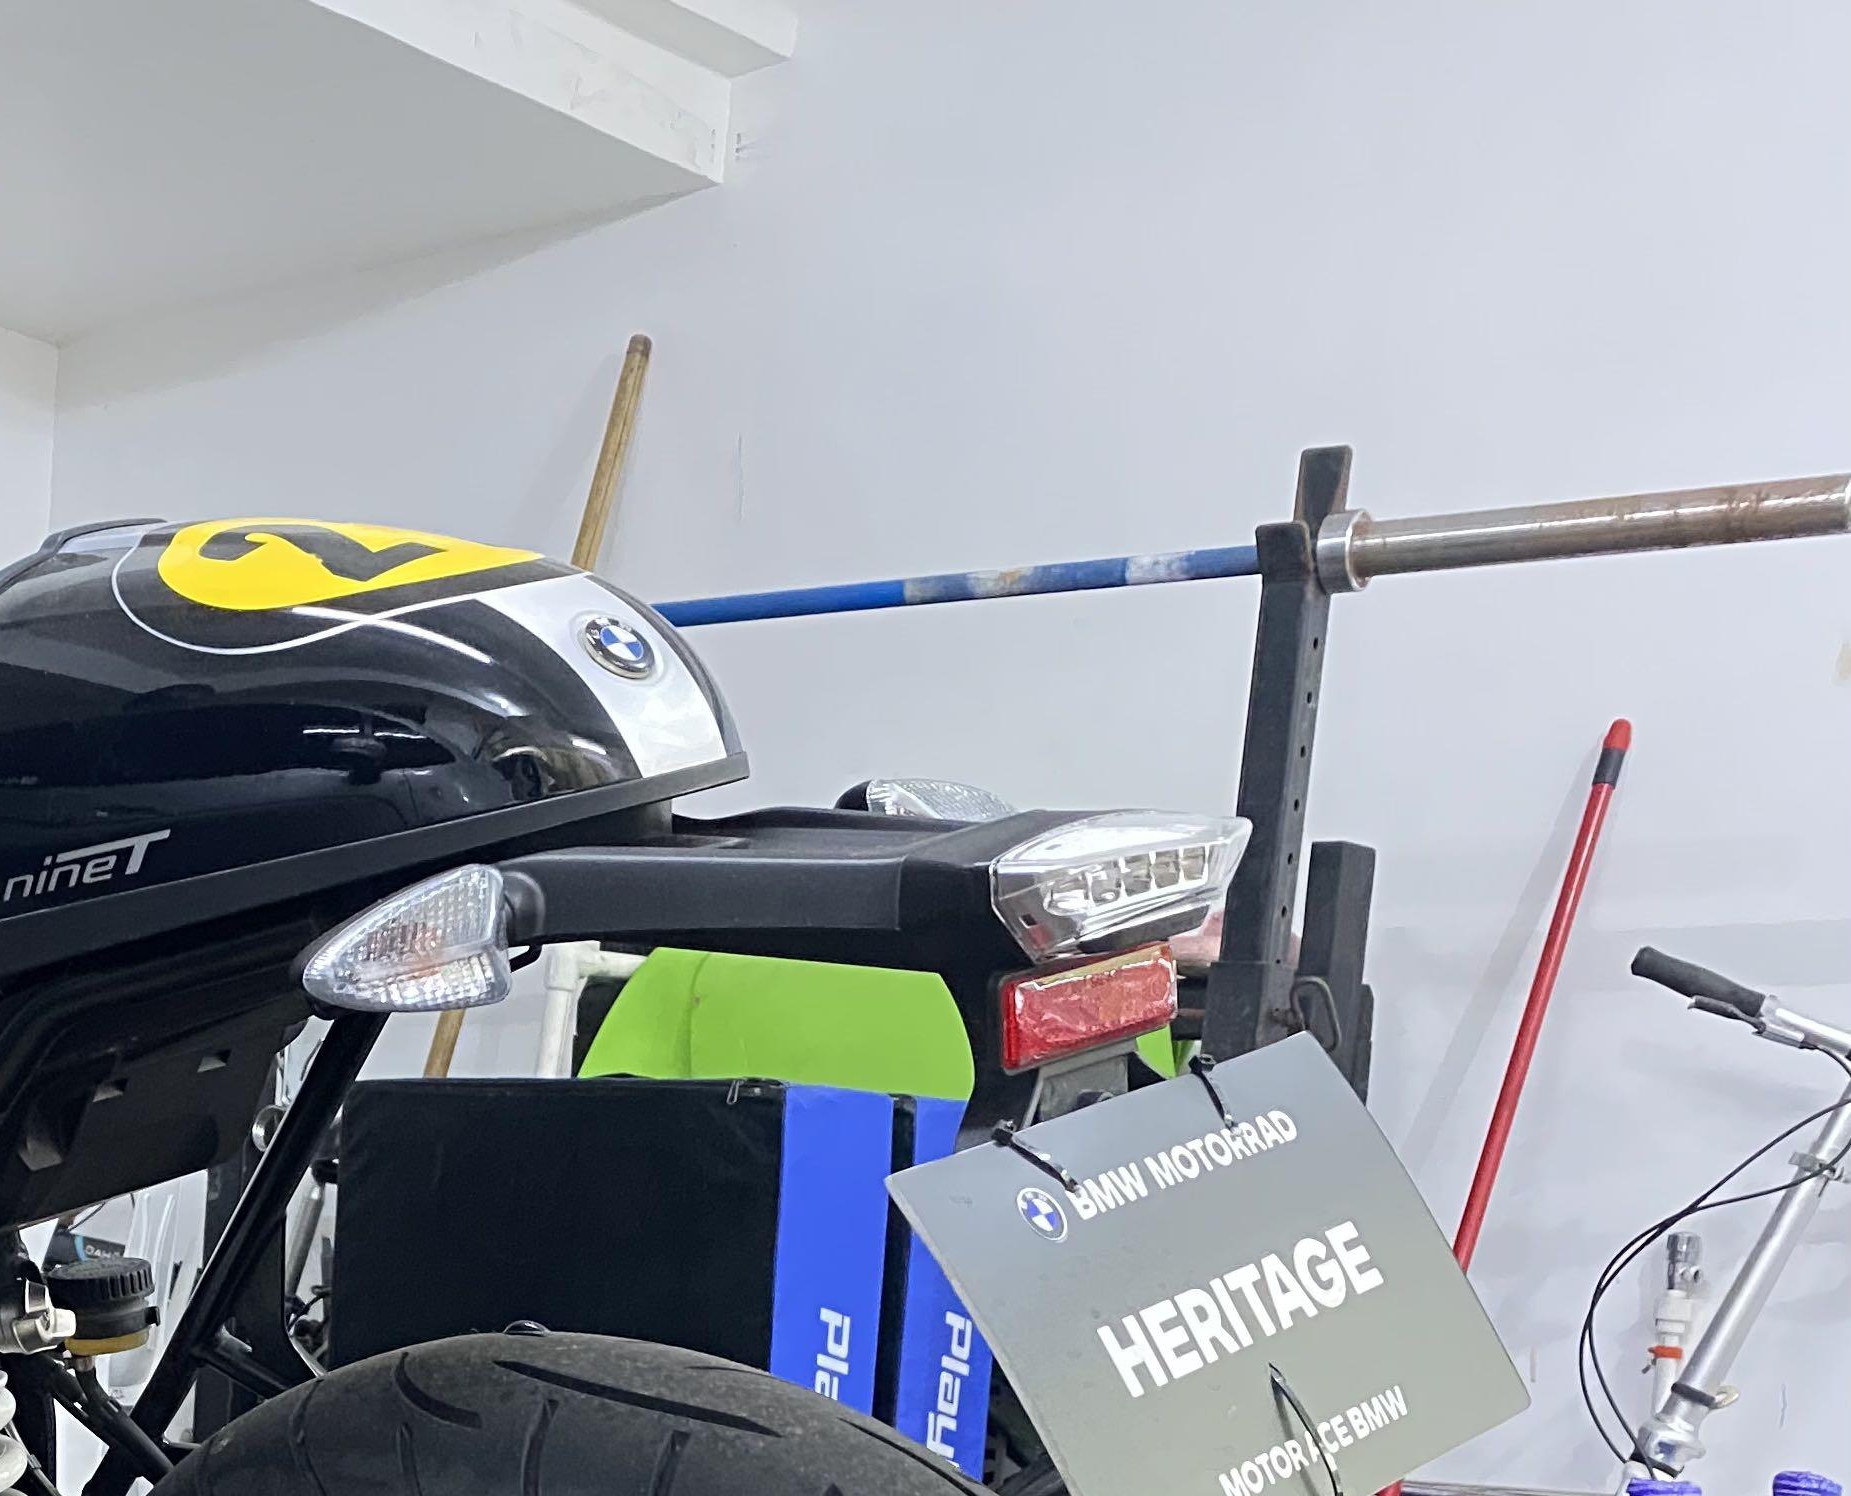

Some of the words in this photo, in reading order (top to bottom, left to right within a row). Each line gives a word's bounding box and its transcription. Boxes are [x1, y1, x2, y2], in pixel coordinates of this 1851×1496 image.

[3, 829, 171, 902] nineT
[1065, 1162, 1148, 1220] BMW
[1144, 1110, 1297, 1189] MOTORRAD
[1097, 1221, 1384, 1398] HERITAGE
[927, 1311, 972, 1468] Play
[1346, 1385, 1408, 1439] BMW
